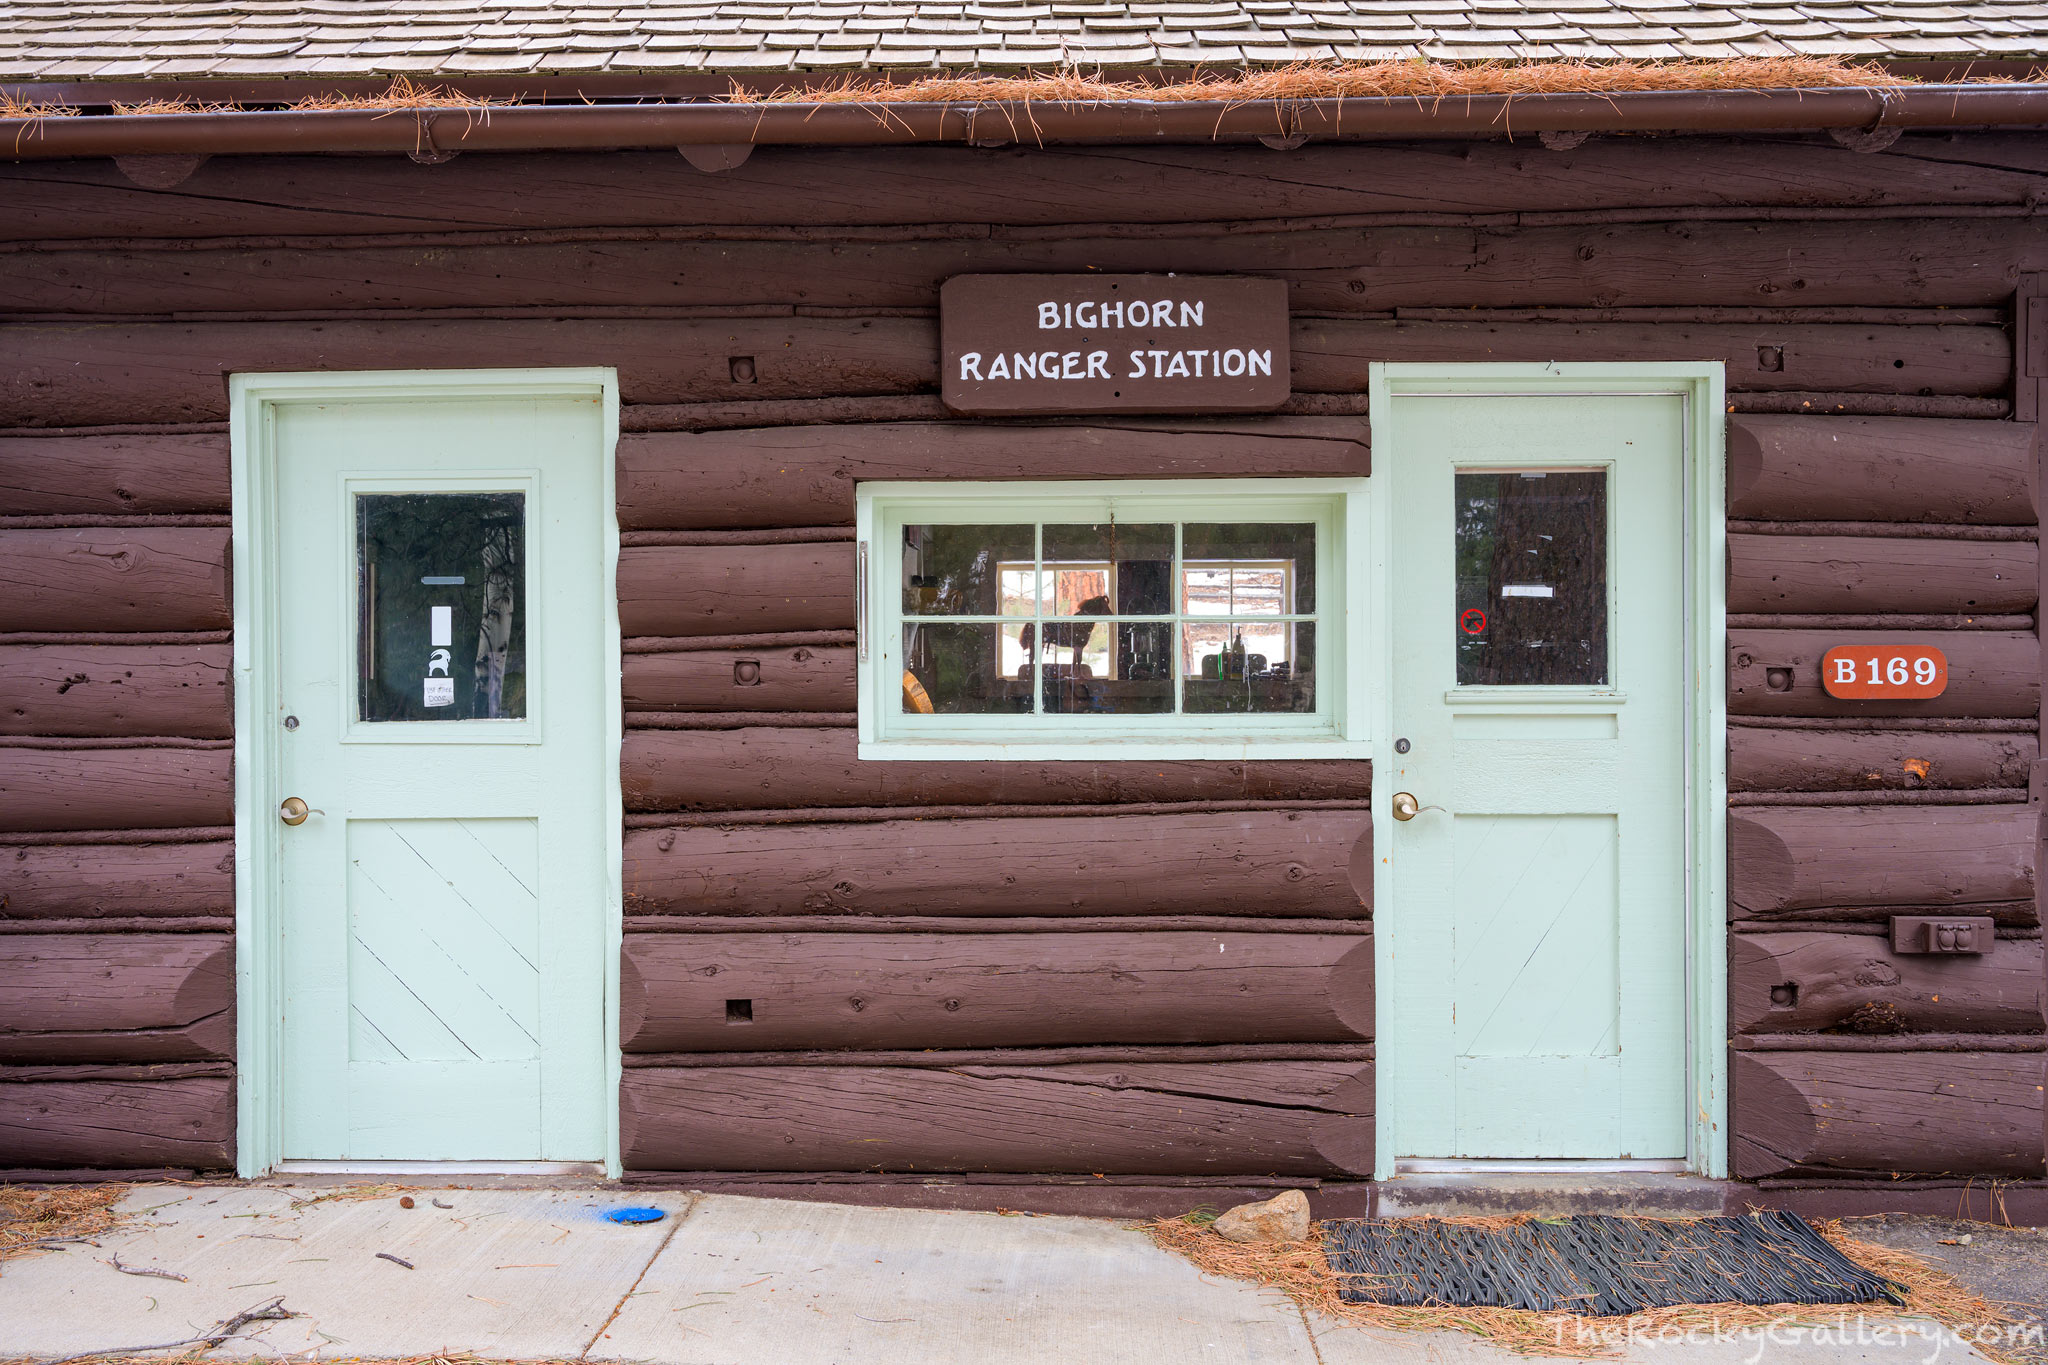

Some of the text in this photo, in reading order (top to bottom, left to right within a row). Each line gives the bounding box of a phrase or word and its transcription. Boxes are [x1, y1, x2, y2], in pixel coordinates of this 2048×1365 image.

[1037, 300, 1204, 329] BIGHORN
[960, 348, 1272, 380] RANGER STATION
[1833, 657, 1936, 685] B 169
